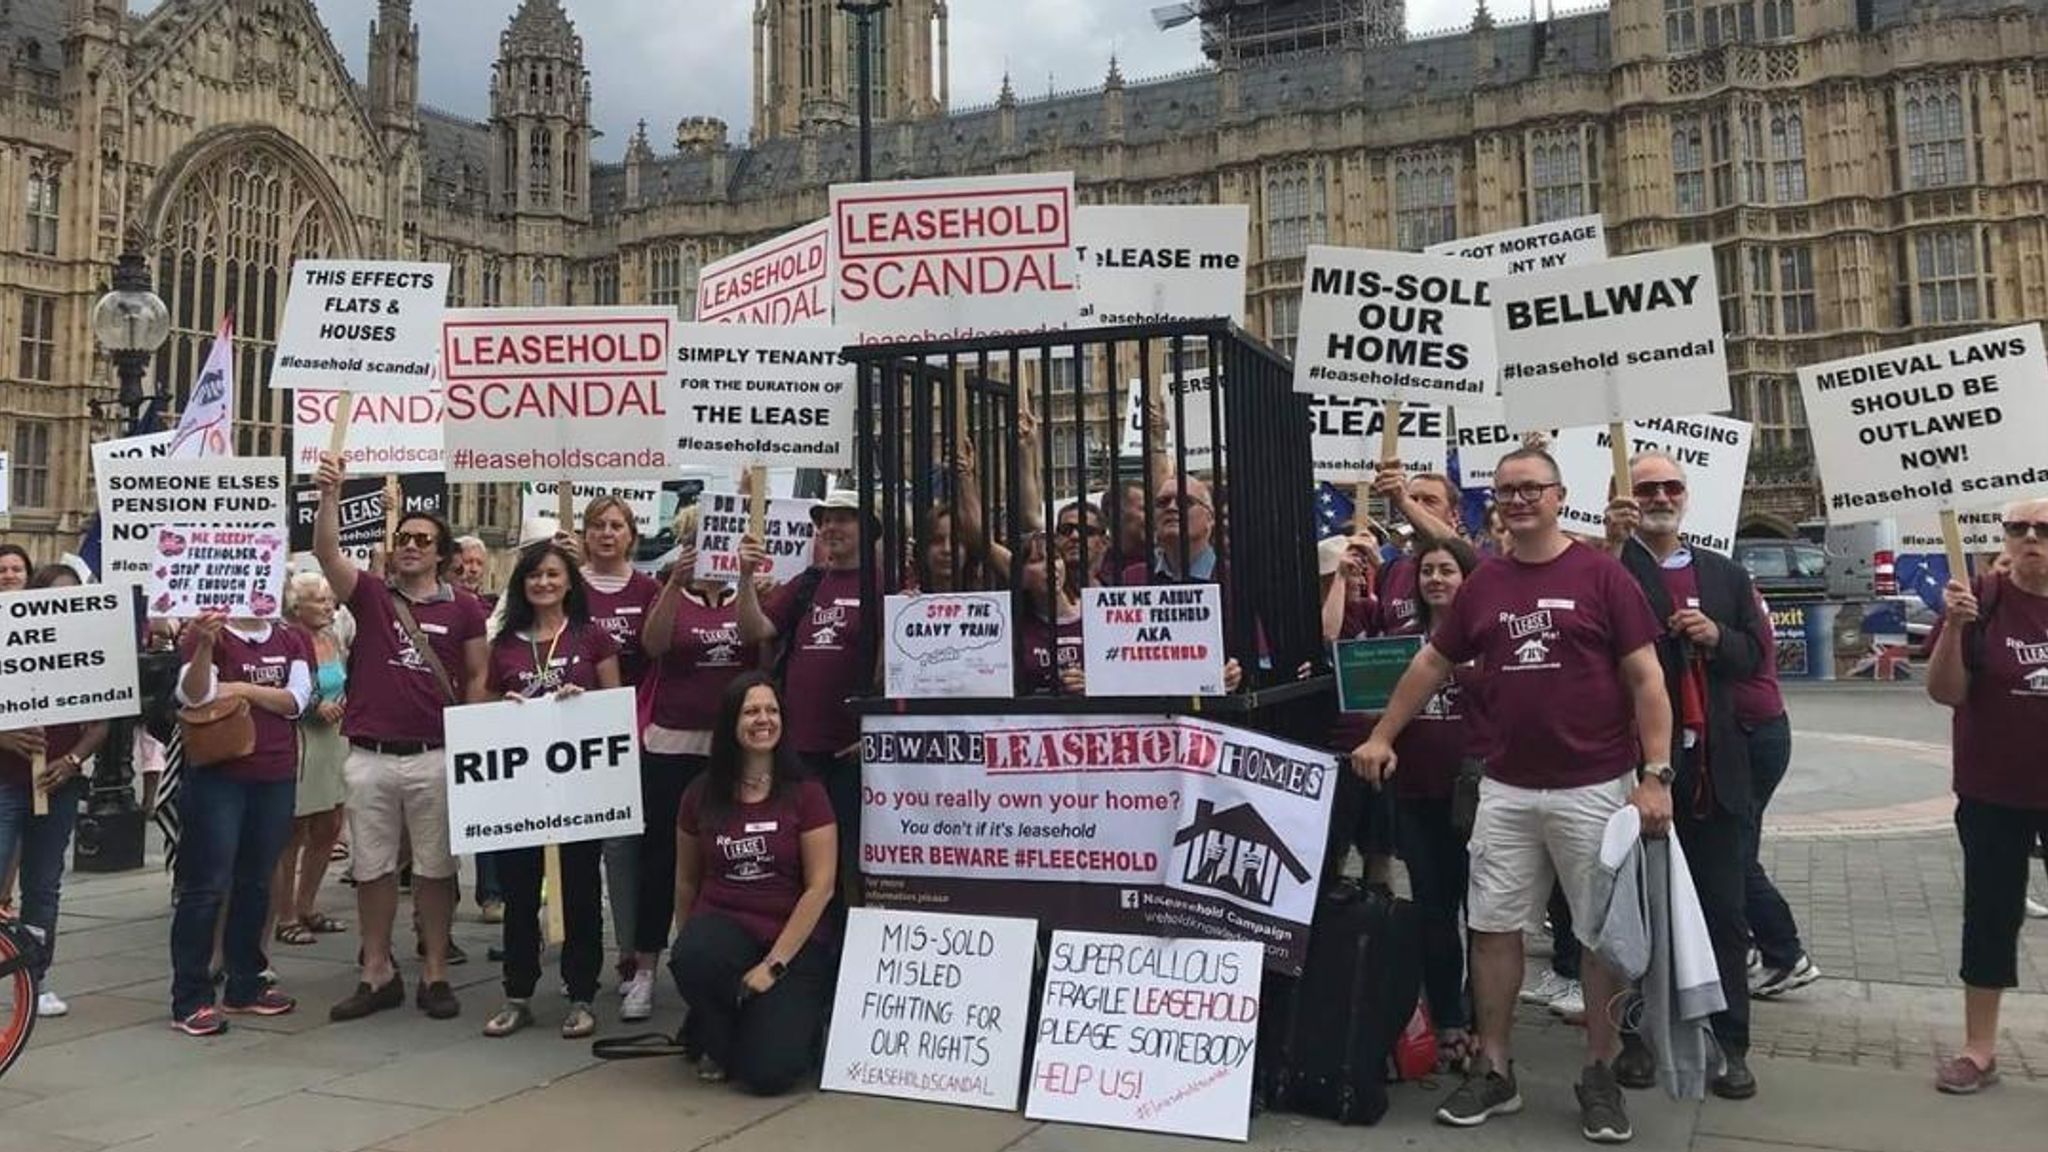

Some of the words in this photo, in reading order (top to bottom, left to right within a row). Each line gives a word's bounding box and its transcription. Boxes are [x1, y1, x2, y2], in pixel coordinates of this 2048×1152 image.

[846, 203, 1061, 244] LEASEHOLD
[1500, 226, 1596, 255] MORTGAGE
[1200, 253, 1240, 269] me
[1541, 253, 1567, 268] MY
[304, 270, 345, 287] THIS
[350, 271, 435, 289] EFFECTS
[702, 243, 823, 311] LEASEHOLD
[839, 254, 1073, 302] SCANDAL
[324, 297, 382, 315] FLATS
[387, 300, 401, 316] &
[1506, 274, 1701, 331] BELLWAY
[1358, 303, 1444, 336] OUR
[319, 324, 397, 343] HOUSES
[452, 331, 661, 366] LEASEHOLD
[678, 347, 750, 365] SIMPLY
[757, 348, 849, 366] TENANTS
[1326, 332, 1470, 372] HOMES
[1503, 352, 1619, 380] #leasehold
[1626, 340, 1715, 366] scandal
[280, 355, 363, 374] #leasehold
[365, 358, 431, 377] scandal
[1816, 354, 1941, 392] MEDIEVAL
[1950, 337, 2026, 367] LAWS
[680, 378, 710, 391] FOR
[713, 379, 743, 392] THE
[745, 379, 821, 393] DURATION
[824, 381, 843, 394] OF
[1308, 365, 1485, 394] #leaseholdscandal
[446, 379, 667, 420] SCANDAL
[1850, 384, 1955, 416] SHOULD
[1963, 375, 1999, 397] BE
[297, 394, 444, 425] SCAND
[692, 405, 742, 425] THE
[750, 407, 830, 426] LEASE
[1858, 406, 2003, 445] OUTLAWED
[677, 436, 841, 456] #leaseholdscandal
[1900, 444, 1970, 471] NOW!
[109, 475, 212, 491] SOMEONE
[217, 475, 281, 490] ELSES
[1831, 477, 1954, 511] #leasehold
[111, 497, 208, 513] PENSION
[213, 497, 278, 512] FUND-
[405, 493, 441, 513] Me!
[187, 547, 258, 561] FREEHOLDER
[701, 534, 731, 552] ARE
[170, 563, 200, 576] STOP
[206, 563, 250, 577] RIPPING
[255, 564, 272, 577] US
[168, 579, 191, 591] OFF
[197, 579, 247, 591] ENOUGH
[10, 594, 119, 619] OWNERS
[927, 604, 963, 619] STOP
[967, 603, 991, 618] THE
[1096, 591, 1128, 608] ASK
[1132, 591, 1153, 607] ME
[1158, 590, 1204, 605] ABOUT
[1105, 608, 1145, 625] FAKE
[1150, 606, 1211, 623] FREEHOLD
[1513, 613, 1548, 637] LEASE
[6, 627, 58, 647] ARE
[960, 623, 1000, 638] TRAIN
[1136, 626, 1173, 643] AKA
[1105, 645, 1209, 662] #FLEECEHOLD
[55, 686, 134, 708] scandal
[453, 746, 529, 785] RIP
[545, 734, 631, 775] OFF
[863, 731, 984, 765] BEWARE
[985, 729, 1219, 770] LEASEHOLD
[1221, 743, 1325, 799] HOMES
[864, 787, 890, 808] Do
[893, 789, 929, 813] you
[935, 786, 992, 814] really
[998, 790, 1044, 811] own
[1048, 790, 1100, 812] your
[1105, 789, 1180, 811] home?
[464, 806, 632, 839] #leaseholdscandal
[900, 819, 930, 836] You
[933, 819, 973, 838] don't
[975, 820, 987, 837] if
[988, 820, 1015, 838] it's
[1018, 821, 1096, 839] leasehold
[864, 843, 924, 865] BUYER
[928, 846, 1009, 868] BEWARE
[1015, 848, 1158, 871] #FLEECEHOLD
[1227, 911, 1293, 941] Campaign
[881, 923, 995, 957] MIS-SOLD
[875, 957, 962, 990] MISLED
[862, 991, 953, 1026] FIGHTING
[967, 1001, 1002, 1033] FOR
[1046, 980, 1129, 1016] FRAGILE
[1132, 986, 1259, 1023] LEASEHOLD
[869, 1029, 910, 1056] OUR
[917, 1031, 991, 1067] RIGHTS
[1037, 1018, 1125, 1053] PLEASE
[1128, 1025, 1255, 1069] SOMEBODY
[1033, 1060, 1094, 1095] HELP
[1099, 1068, 1144, 1100] US!
